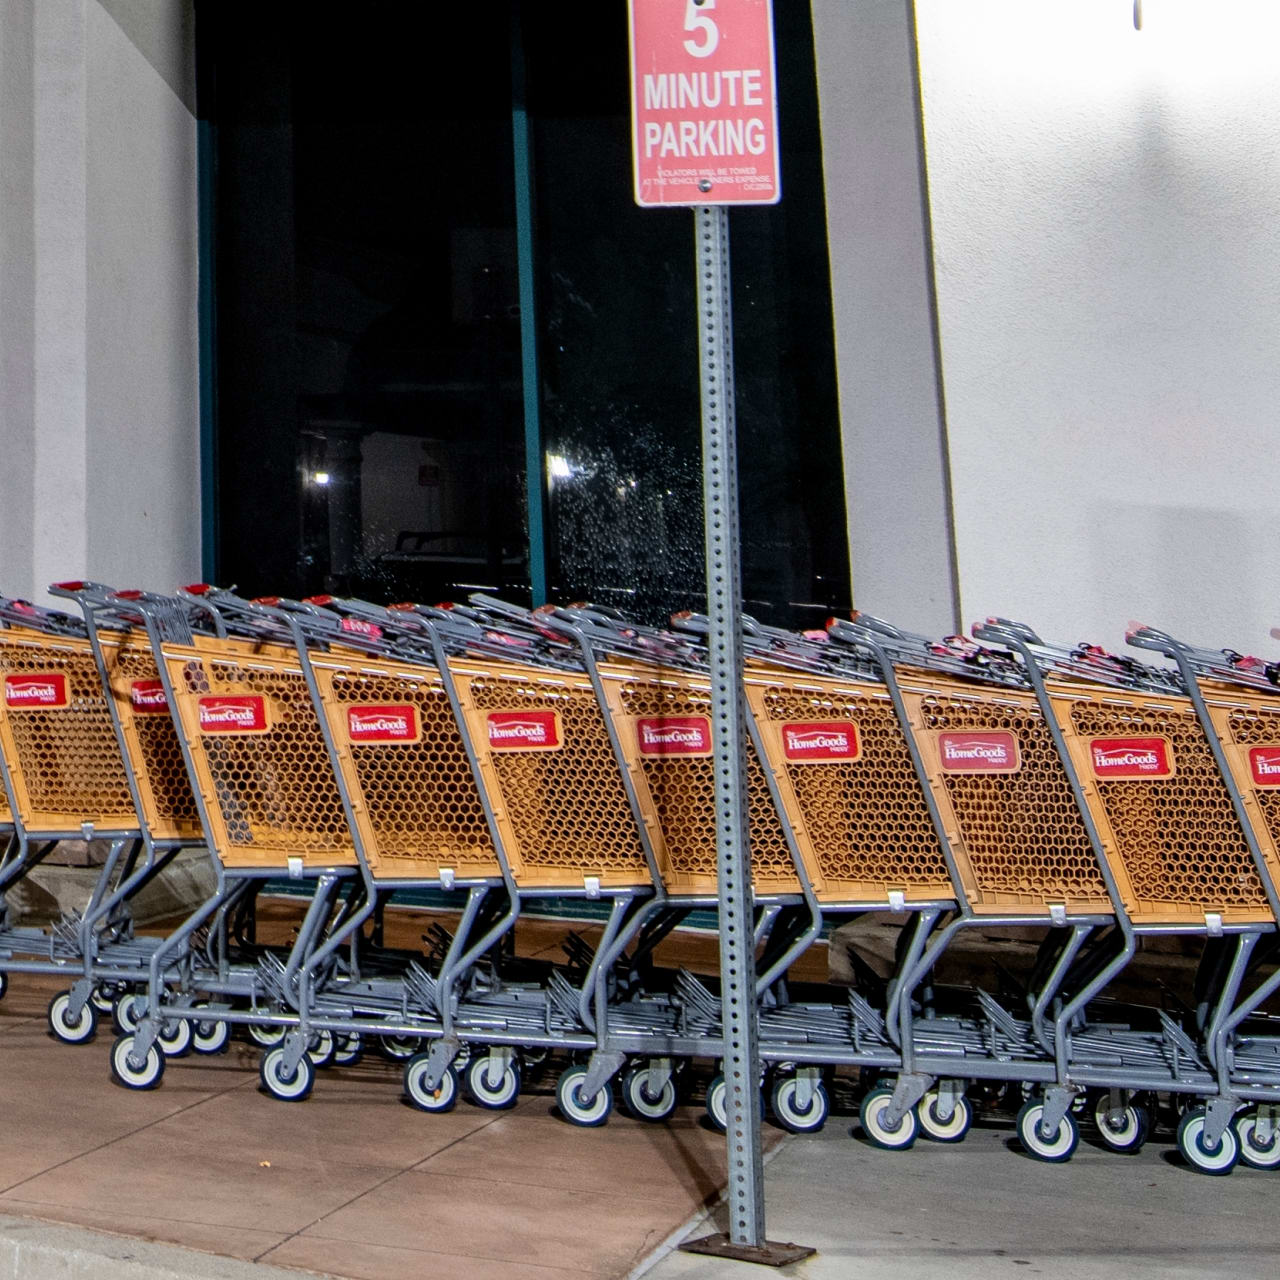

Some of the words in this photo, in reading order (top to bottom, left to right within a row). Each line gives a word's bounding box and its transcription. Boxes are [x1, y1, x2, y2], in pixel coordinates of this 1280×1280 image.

[643, 69, 763, 110] MINUTE
[644, 118, 766, 159] PARKING
[6, 685, 55, 699] HomeGoods
[200, 709, 254, 723] HomeGoods
[351, 719, 407, 732] HomeGoods
[489, 724, 545, 738] HomeGoods
[644, 730, 702, 744] HomeGoods
[789, 735, 848, 750] HomeGoods
[945, 746, 1006, 759] HomeGoods
[1096, 752, 1158, 767] HomeGoods
